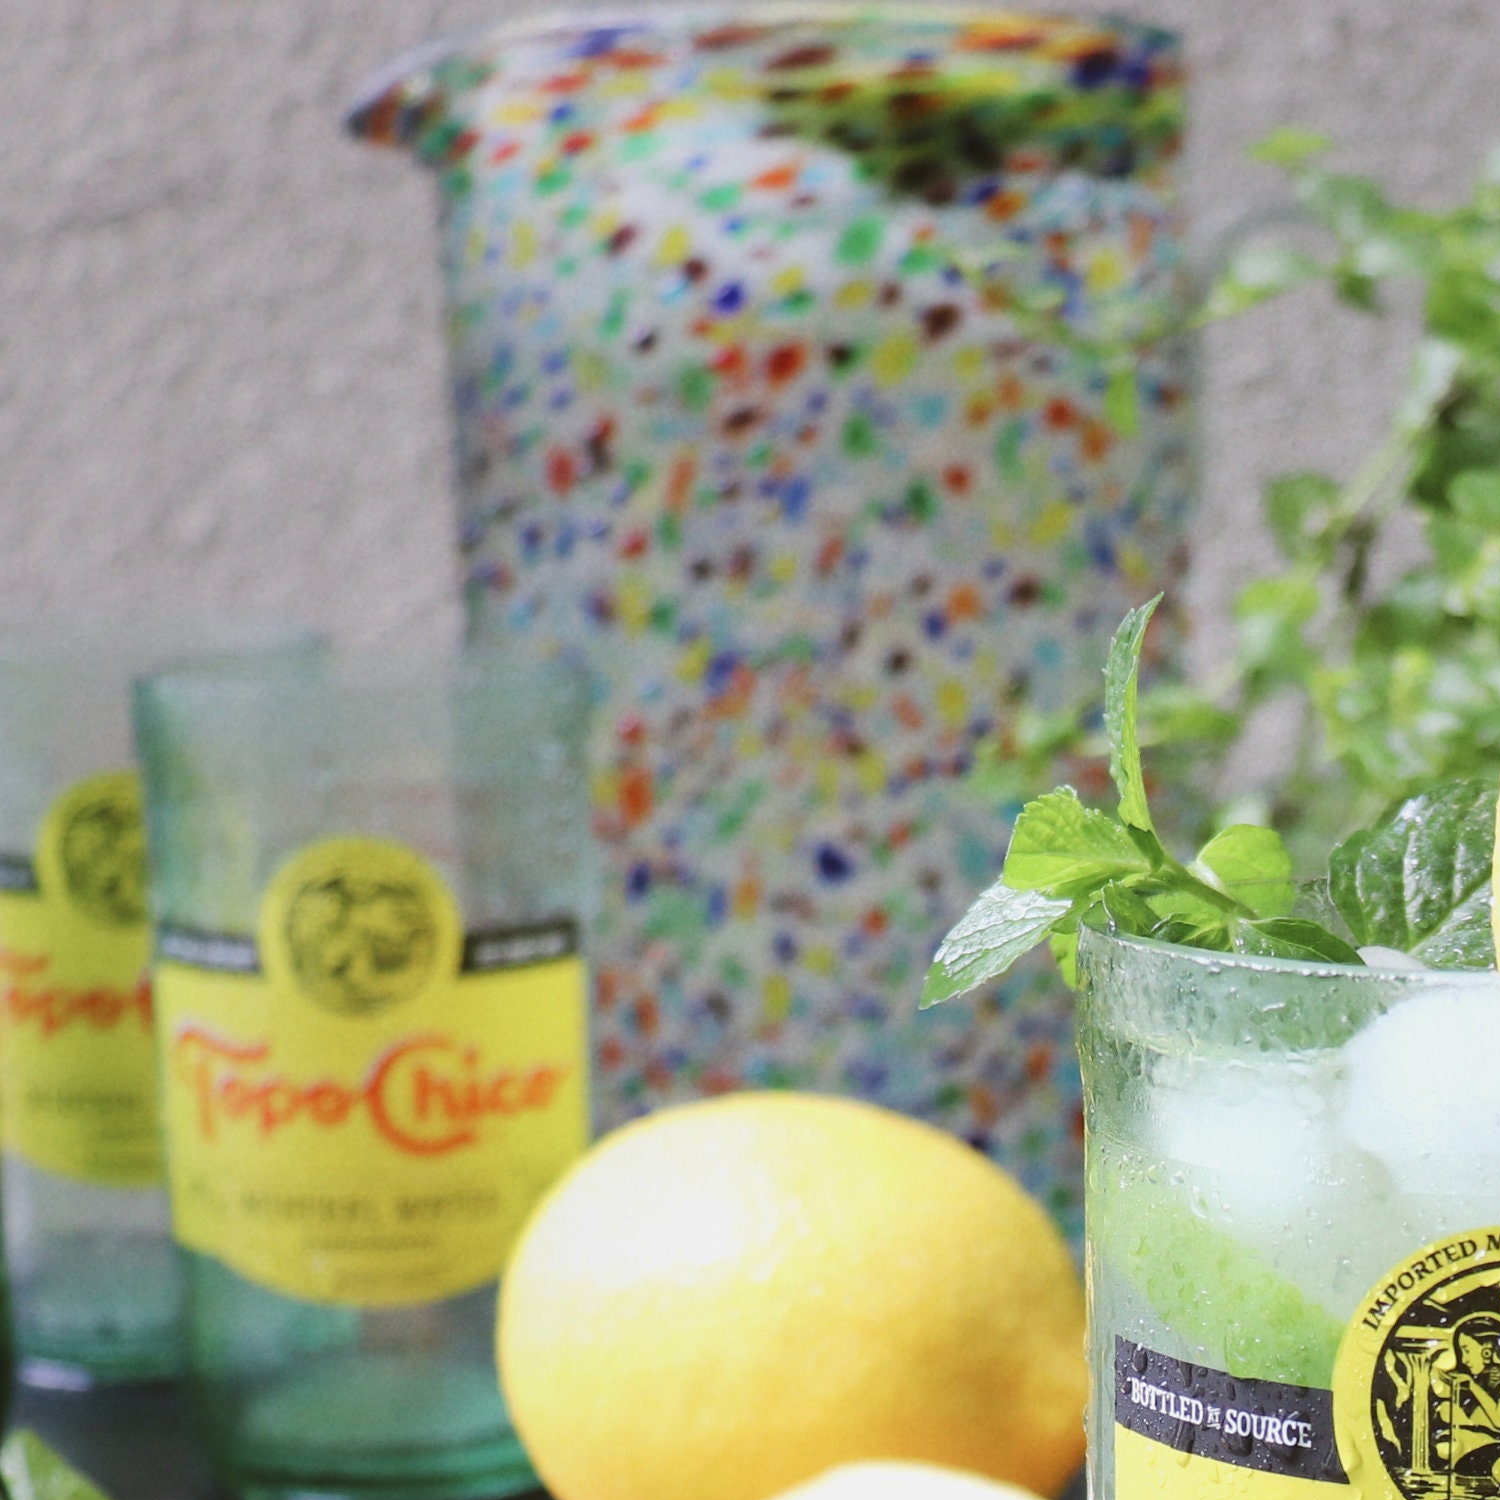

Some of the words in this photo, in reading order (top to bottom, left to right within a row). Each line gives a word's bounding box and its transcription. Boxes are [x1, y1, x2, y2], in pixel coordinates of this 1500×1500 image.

[175, 1020, 362, 1142] Topo
[362, 1030, 572, 1158] Chico
[1361, 1239, 1478, 1331] IMPORTED
[1130, 1376, 1204, 1426] BOTTLED
[1224, 1408, 1313, 1448] SOURCE
